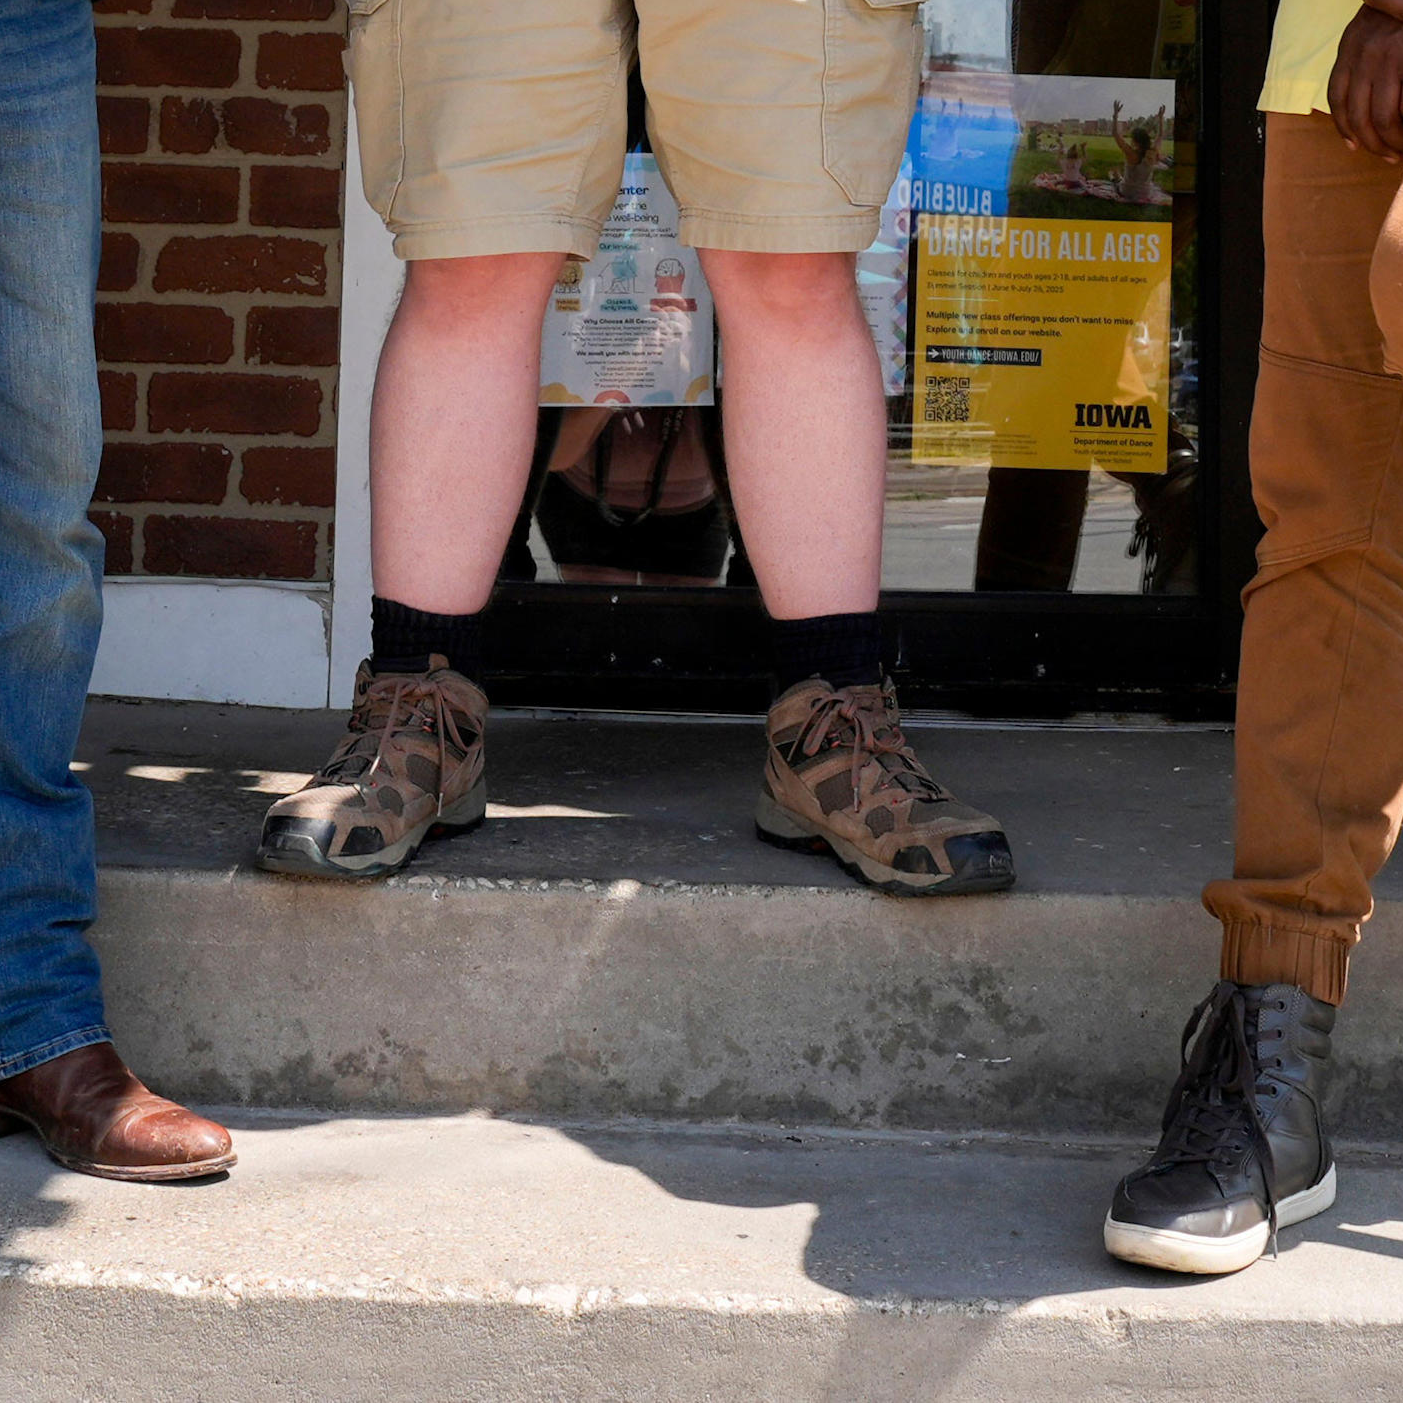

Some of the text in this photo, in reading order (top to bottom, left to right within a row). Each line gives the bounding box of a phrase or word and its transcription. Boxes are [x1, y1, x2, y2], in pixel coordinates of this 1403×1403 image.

[618, 185, 649, 195] enter
[928, 227, 1161, 263] DANCE FOR ALL AGES
[926, 311, 959, 321] Multiple
[980, 312, 1001, 321] class
[1003, 313, 1040, 324] offerings
[1043, 316, 1058, 325] you
[1059, 315, 1080, 324] don't
[1082, 317, 1101, 325] want
[1104, 317, 1112, 325] to
[926, 325, 957, 335] Explore
[975, 326, 999, 335] enroll
[1013, 328, 1026, 336] our
[1075, 403, 1152, 429] IOWA
[1073, 437, 1153, 447] Department of Dance
